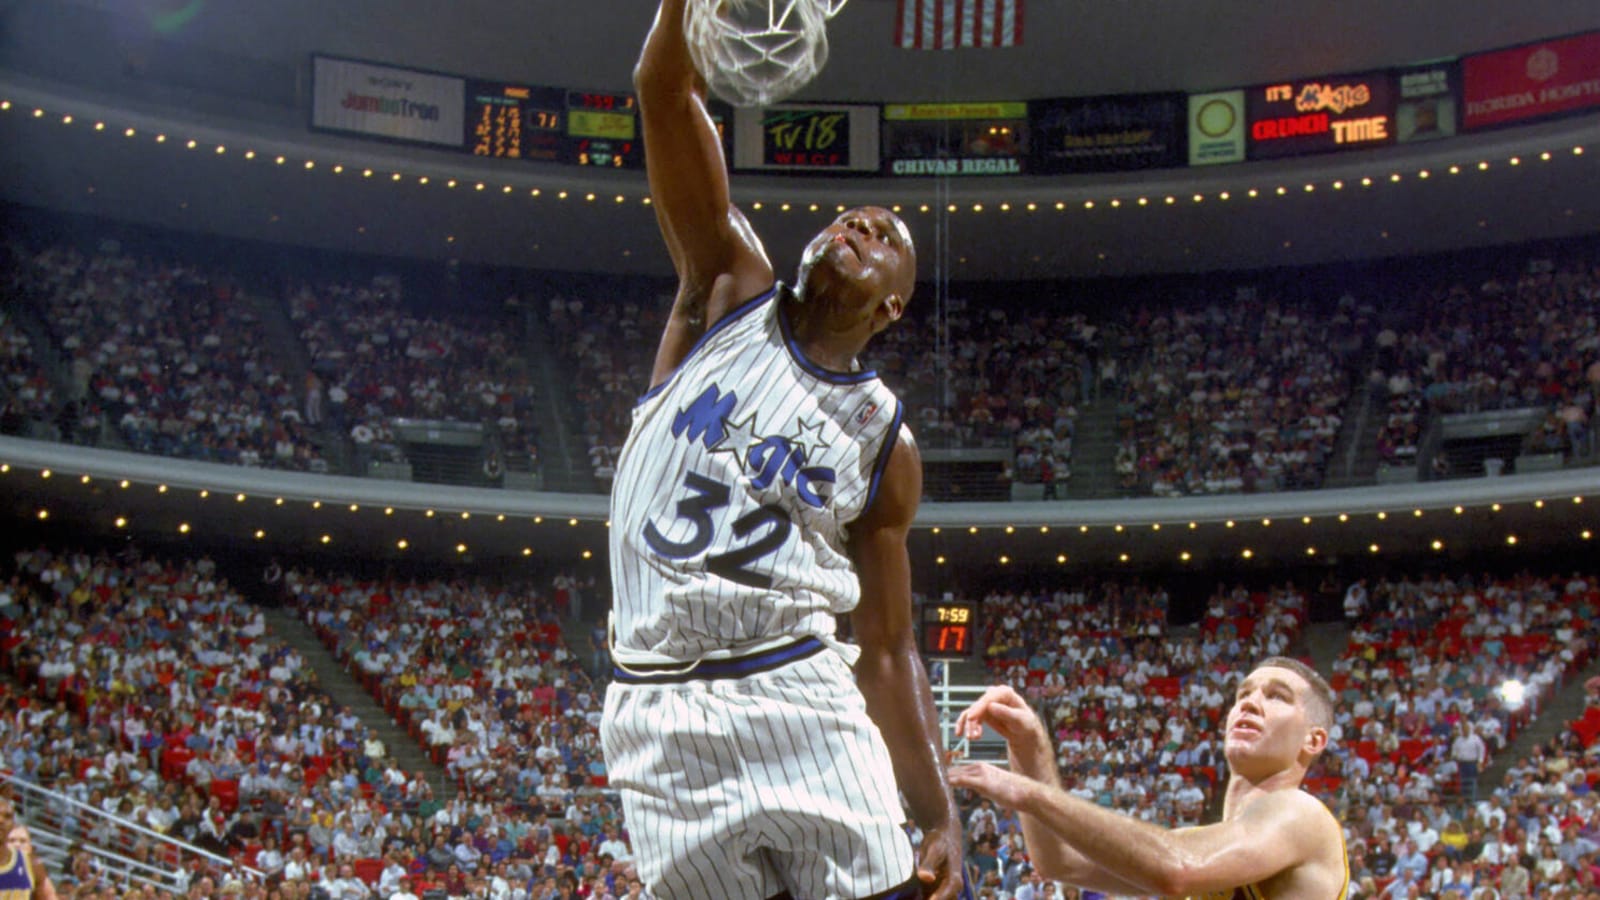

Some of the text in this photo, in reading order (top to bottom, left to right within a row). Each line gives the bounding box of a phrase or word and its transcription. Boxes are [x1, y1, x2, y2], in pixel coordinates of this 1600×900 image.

[1252, 113, 1387, 143] CRUNCH TIME
[893, 158, 1020, 174] CHIVAS REGAL
[642, 470, 792, 588] 32
[938, 607, 969, 622] 7:59
[938, 625, 967, 651] 17
